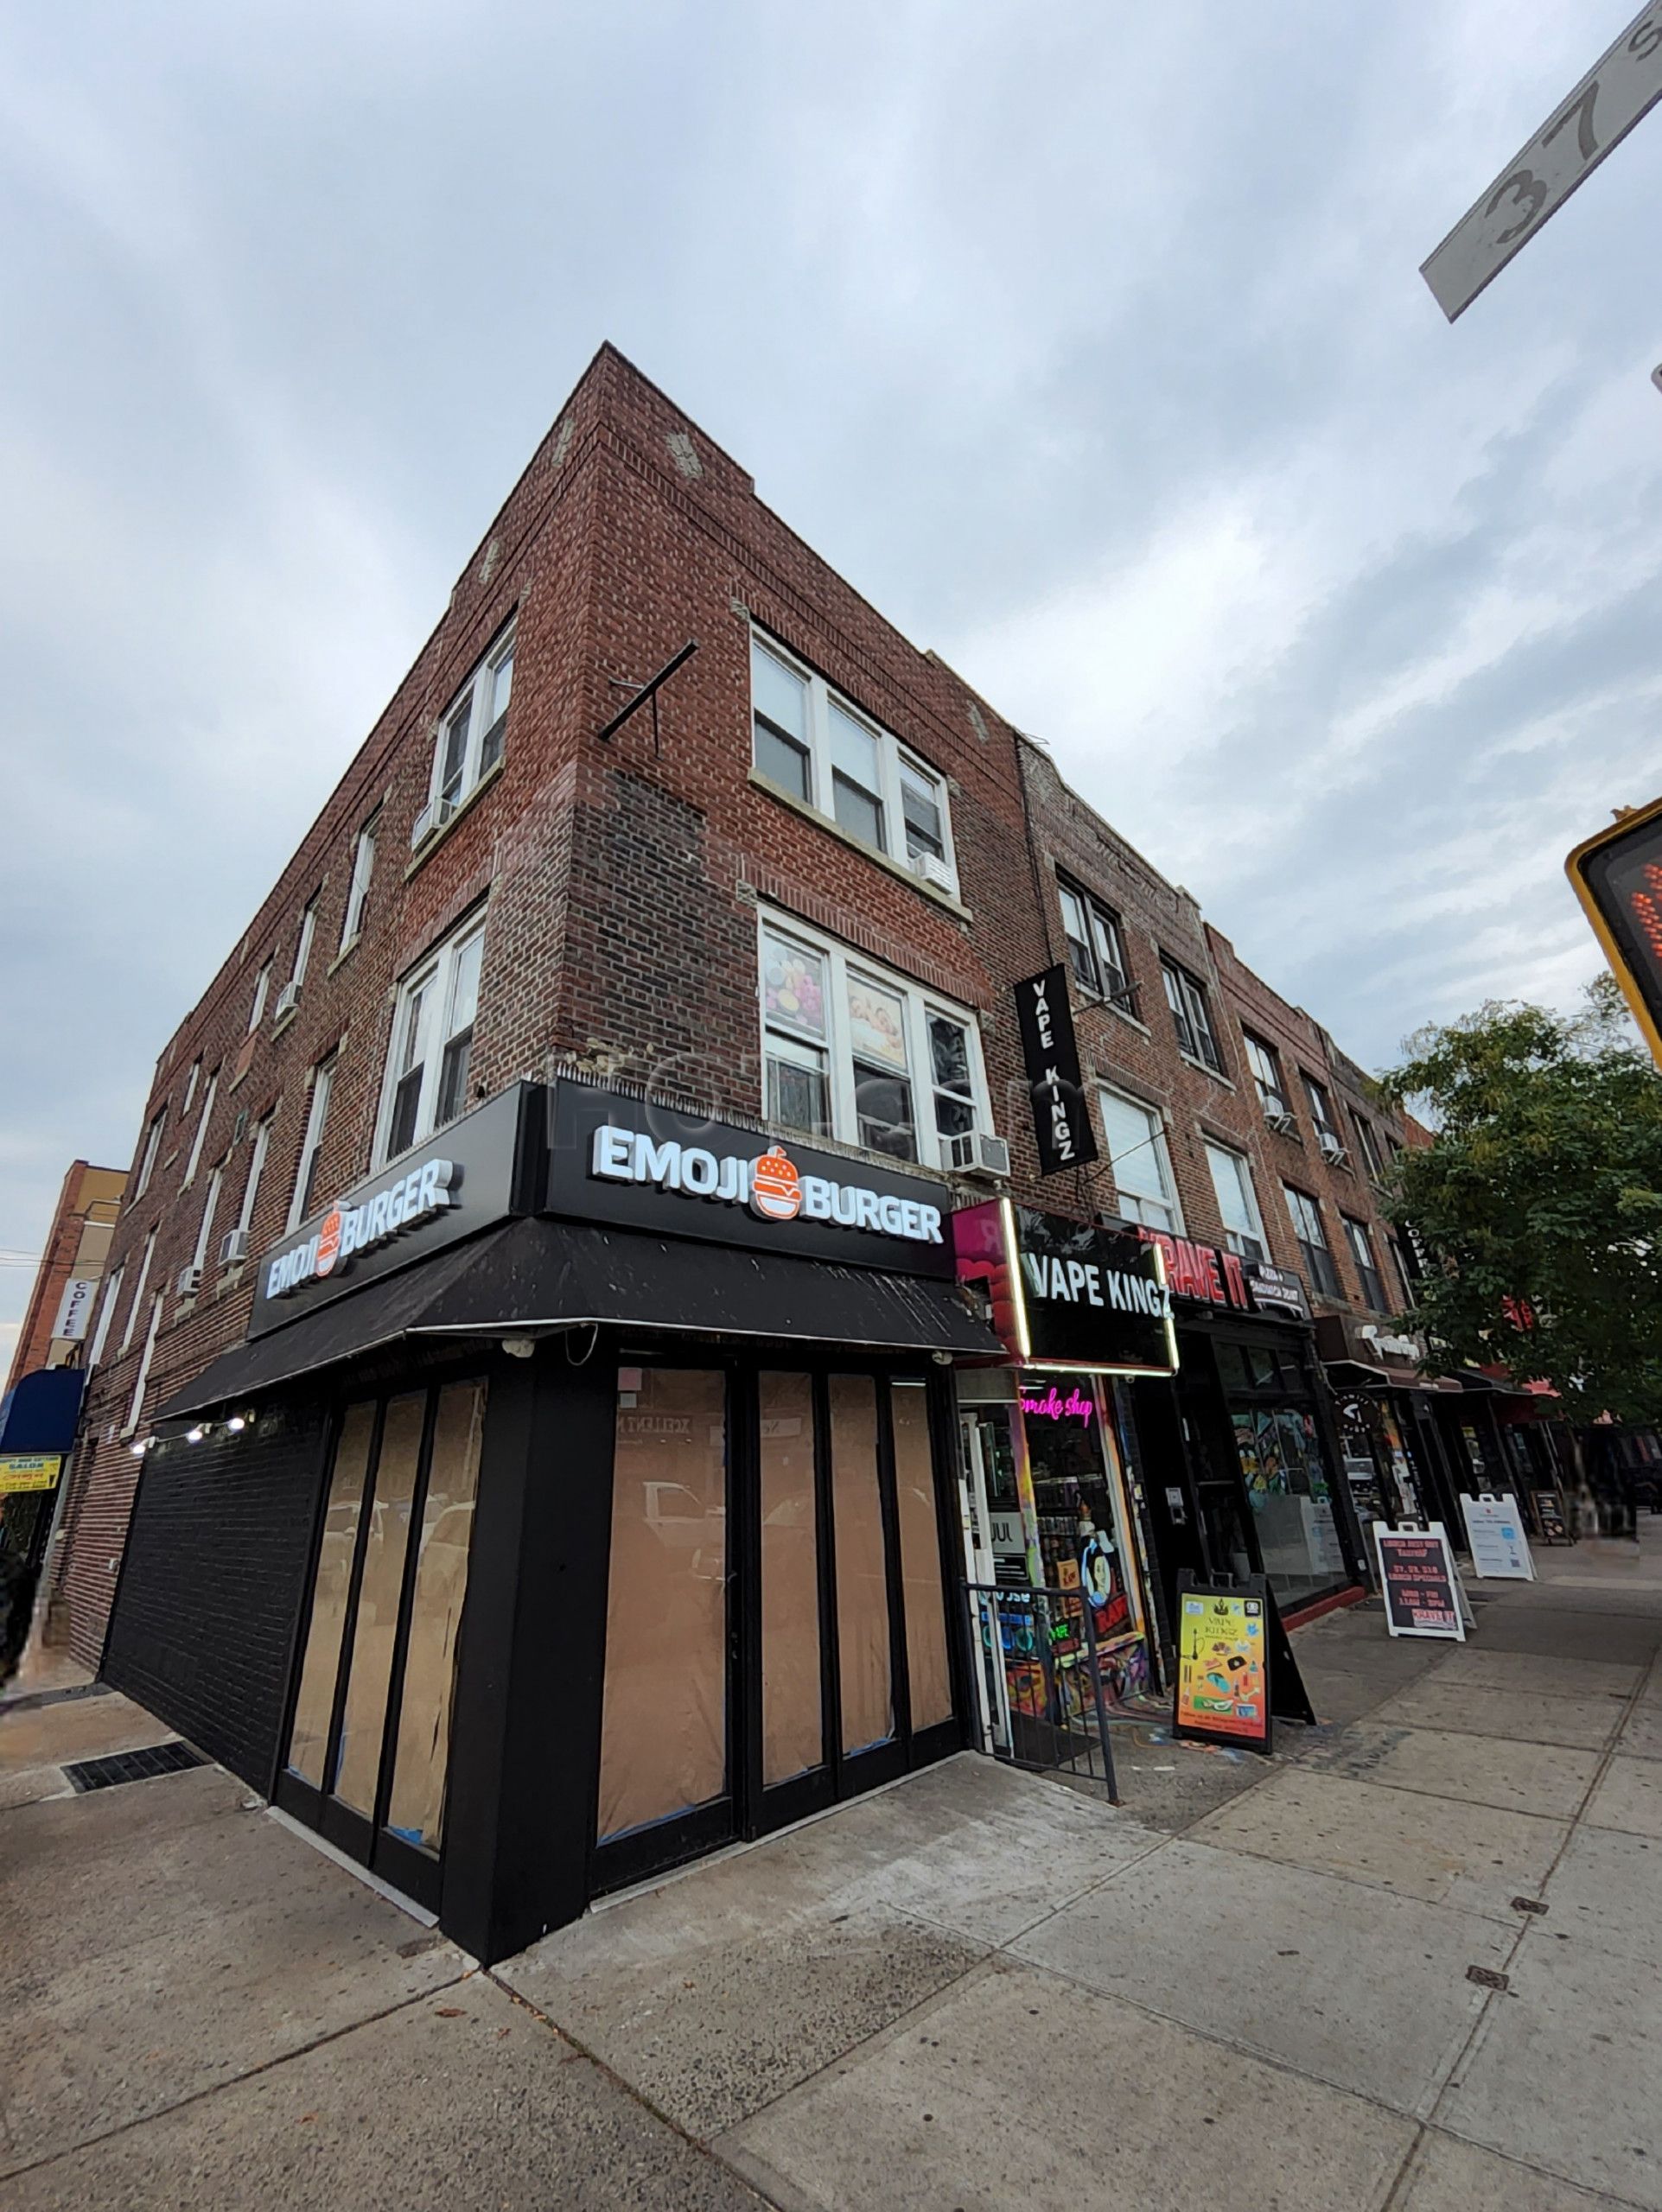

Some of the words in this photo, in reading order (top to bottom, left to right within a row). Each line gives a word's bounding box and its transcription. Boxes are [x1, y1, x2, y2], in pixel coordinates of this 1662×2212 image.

[1484, 79, 1601, 245] 37
[1627, 17, 1662, 62] S
[1033, 979, 1054, 1050] VAPE
[1045, 1065, 1075, 1161] KINGZ
[266, 1235, 321, 1300] EMOJI
[339, 1159, 454, 1257] BURGER
[593, 1125, 750, 1205] EMOJI
[799, 1176, 945, 1244] BURGER
[63, 1282, 87, 1336] COFFEE
[1022, 1252, 1105, 1307] VAPE
[1105, 1269, 1175, 1320] KINGZ
[1137, 1226, 1228, 1308] RAVE
[1221, 1252, 1249, 1311] IT
[1065, 1389, 1093, 1428] shop
